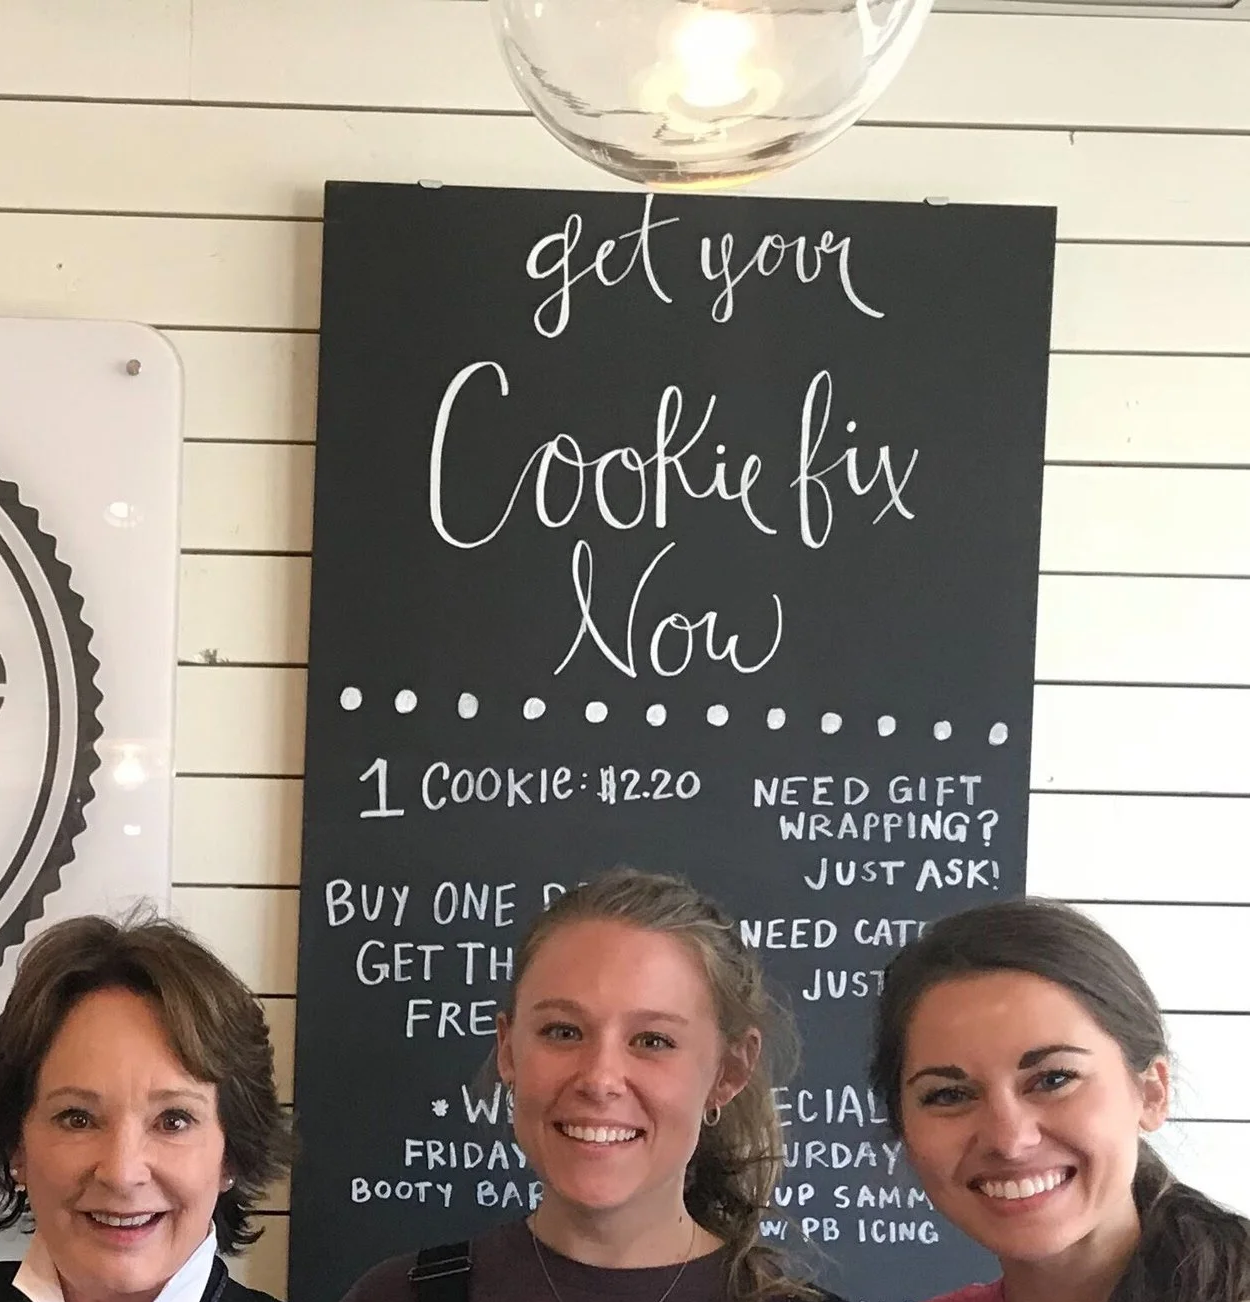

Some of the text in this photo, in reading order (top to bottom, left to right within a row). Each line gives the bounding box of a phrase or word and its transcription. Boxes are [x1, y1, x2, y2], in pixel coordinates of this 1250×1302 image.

[526, 193, 885, 338] get your
[790, 370, 919, 549] fix
[554, 540, 783, 678] Now
[359, 757, 405, 818] 1
[596, 765, 701, 805] $2.20
[754, 775, 981, 807] NEED GIFT
[779, 809, 999, 847] WRAPPING?
[803, 857, 1000, 892] JUST ASK!
[325, 879, 409, 926] BUY
[433, 881, 516, 926] ONE
[740, 918, 838, 949] NEED
[356, 940, 444, 985] GET
[351, 1177, 453, 1207] BOOTY
[801, 1216, 840, 1242] PB
[857, 1220, 940, 1245] ICING
